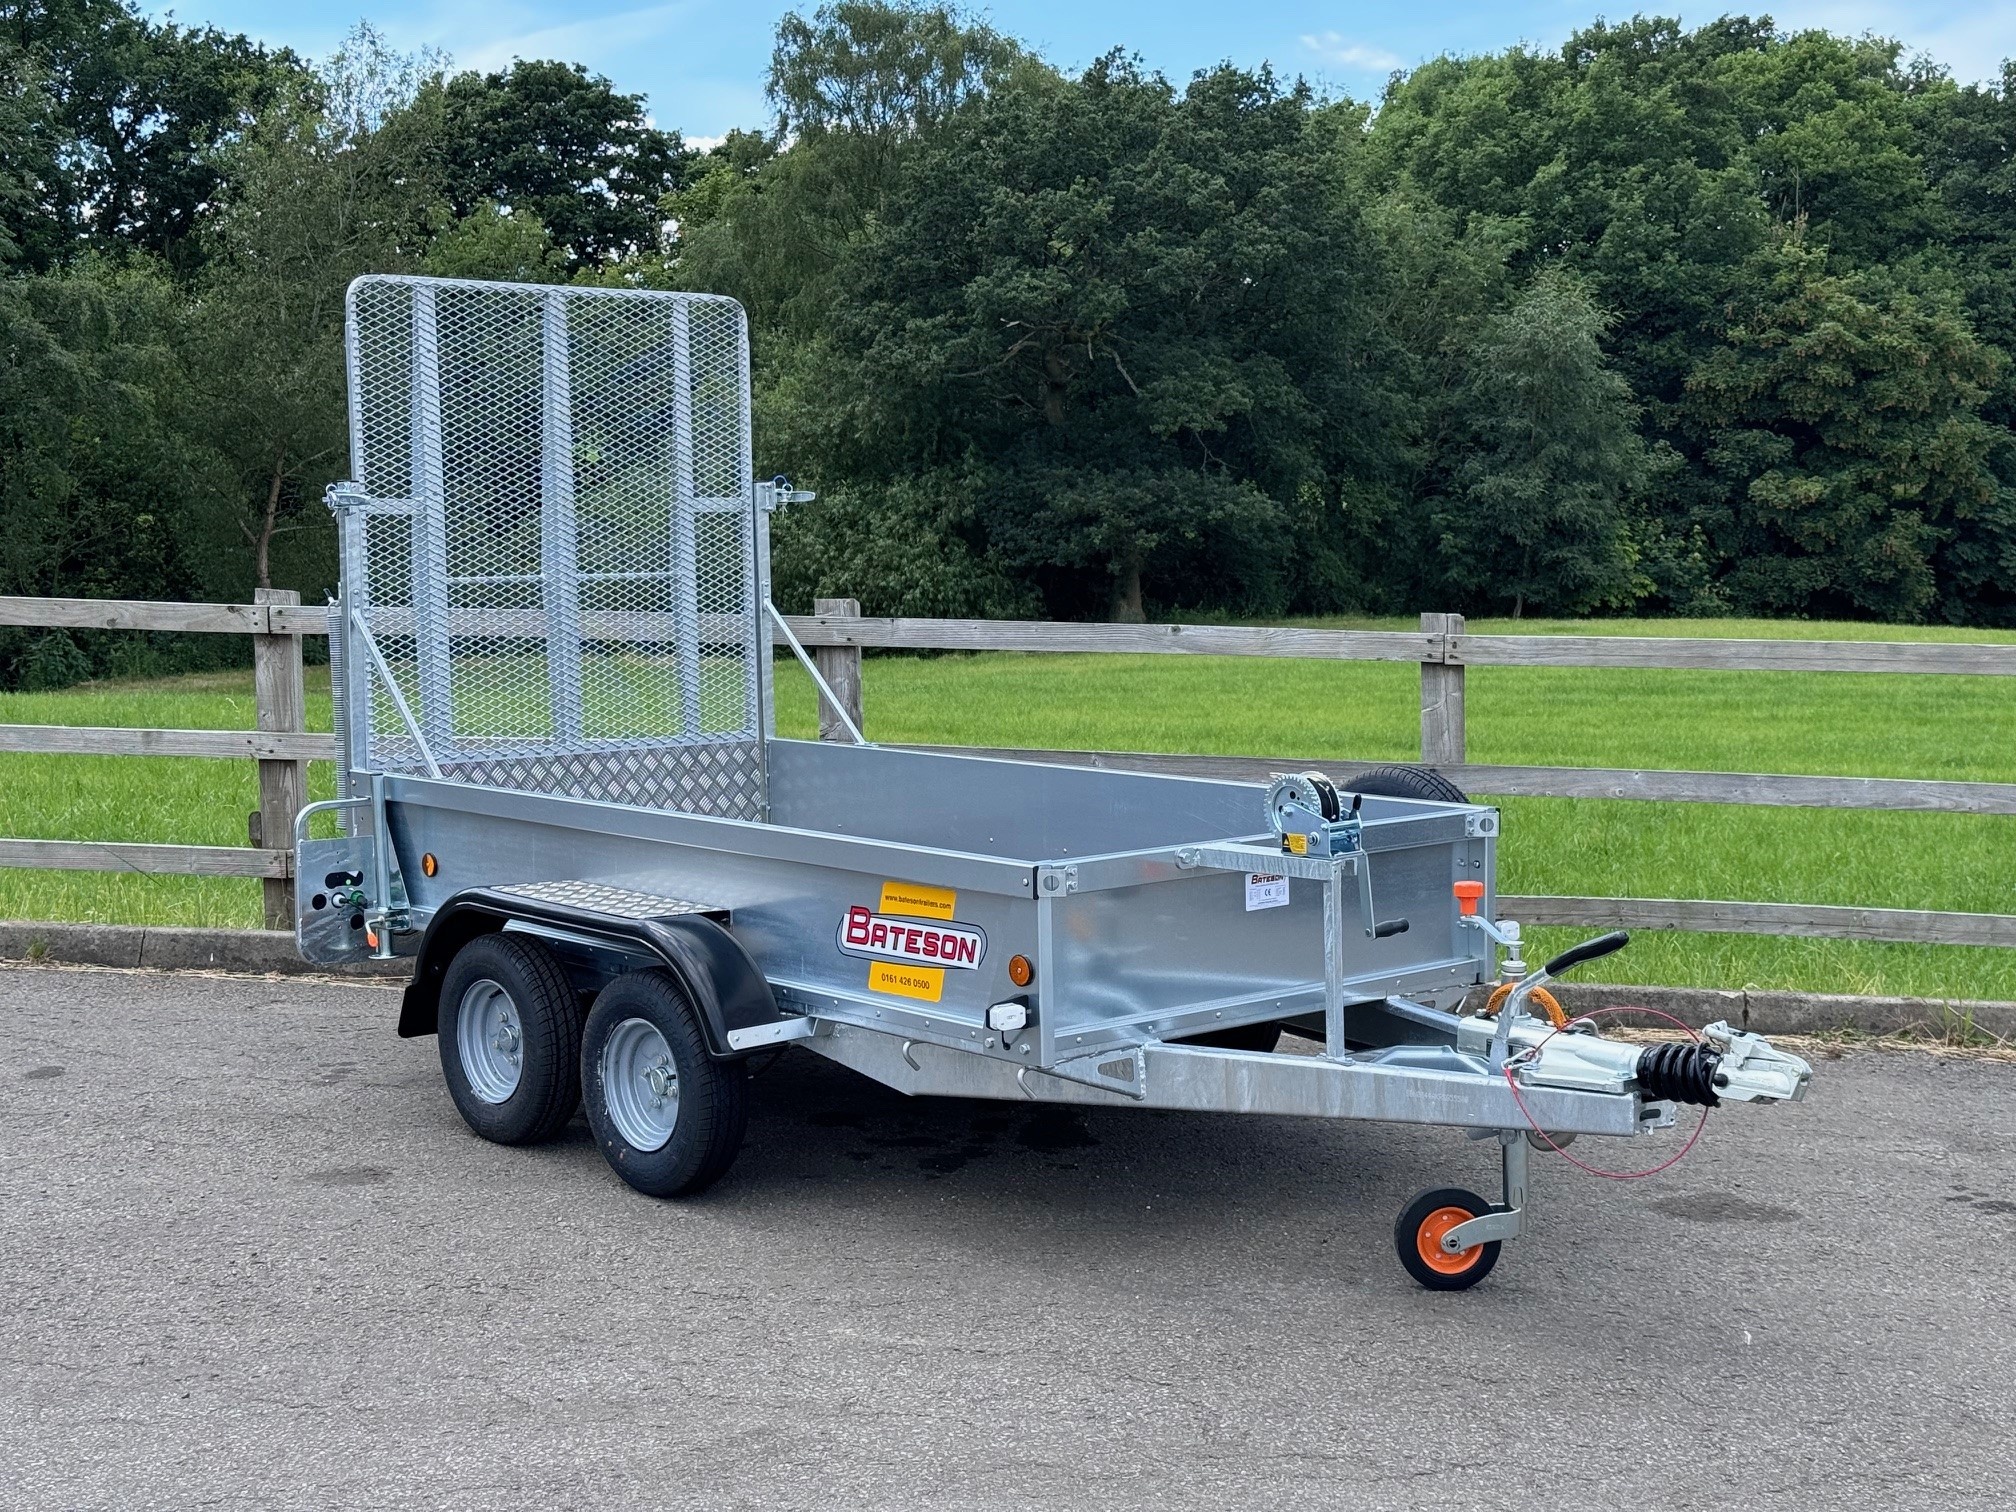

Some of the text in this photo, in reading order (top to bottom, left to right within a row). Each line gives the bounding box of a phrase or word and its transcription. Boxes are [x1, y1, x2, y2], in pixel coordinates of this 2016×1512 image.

[885, 894, 951, 910] www.batesontrailers.com
[846, 905, 977, 963] BATESON
[881, 973, 930, 990] 0161 426 0500
